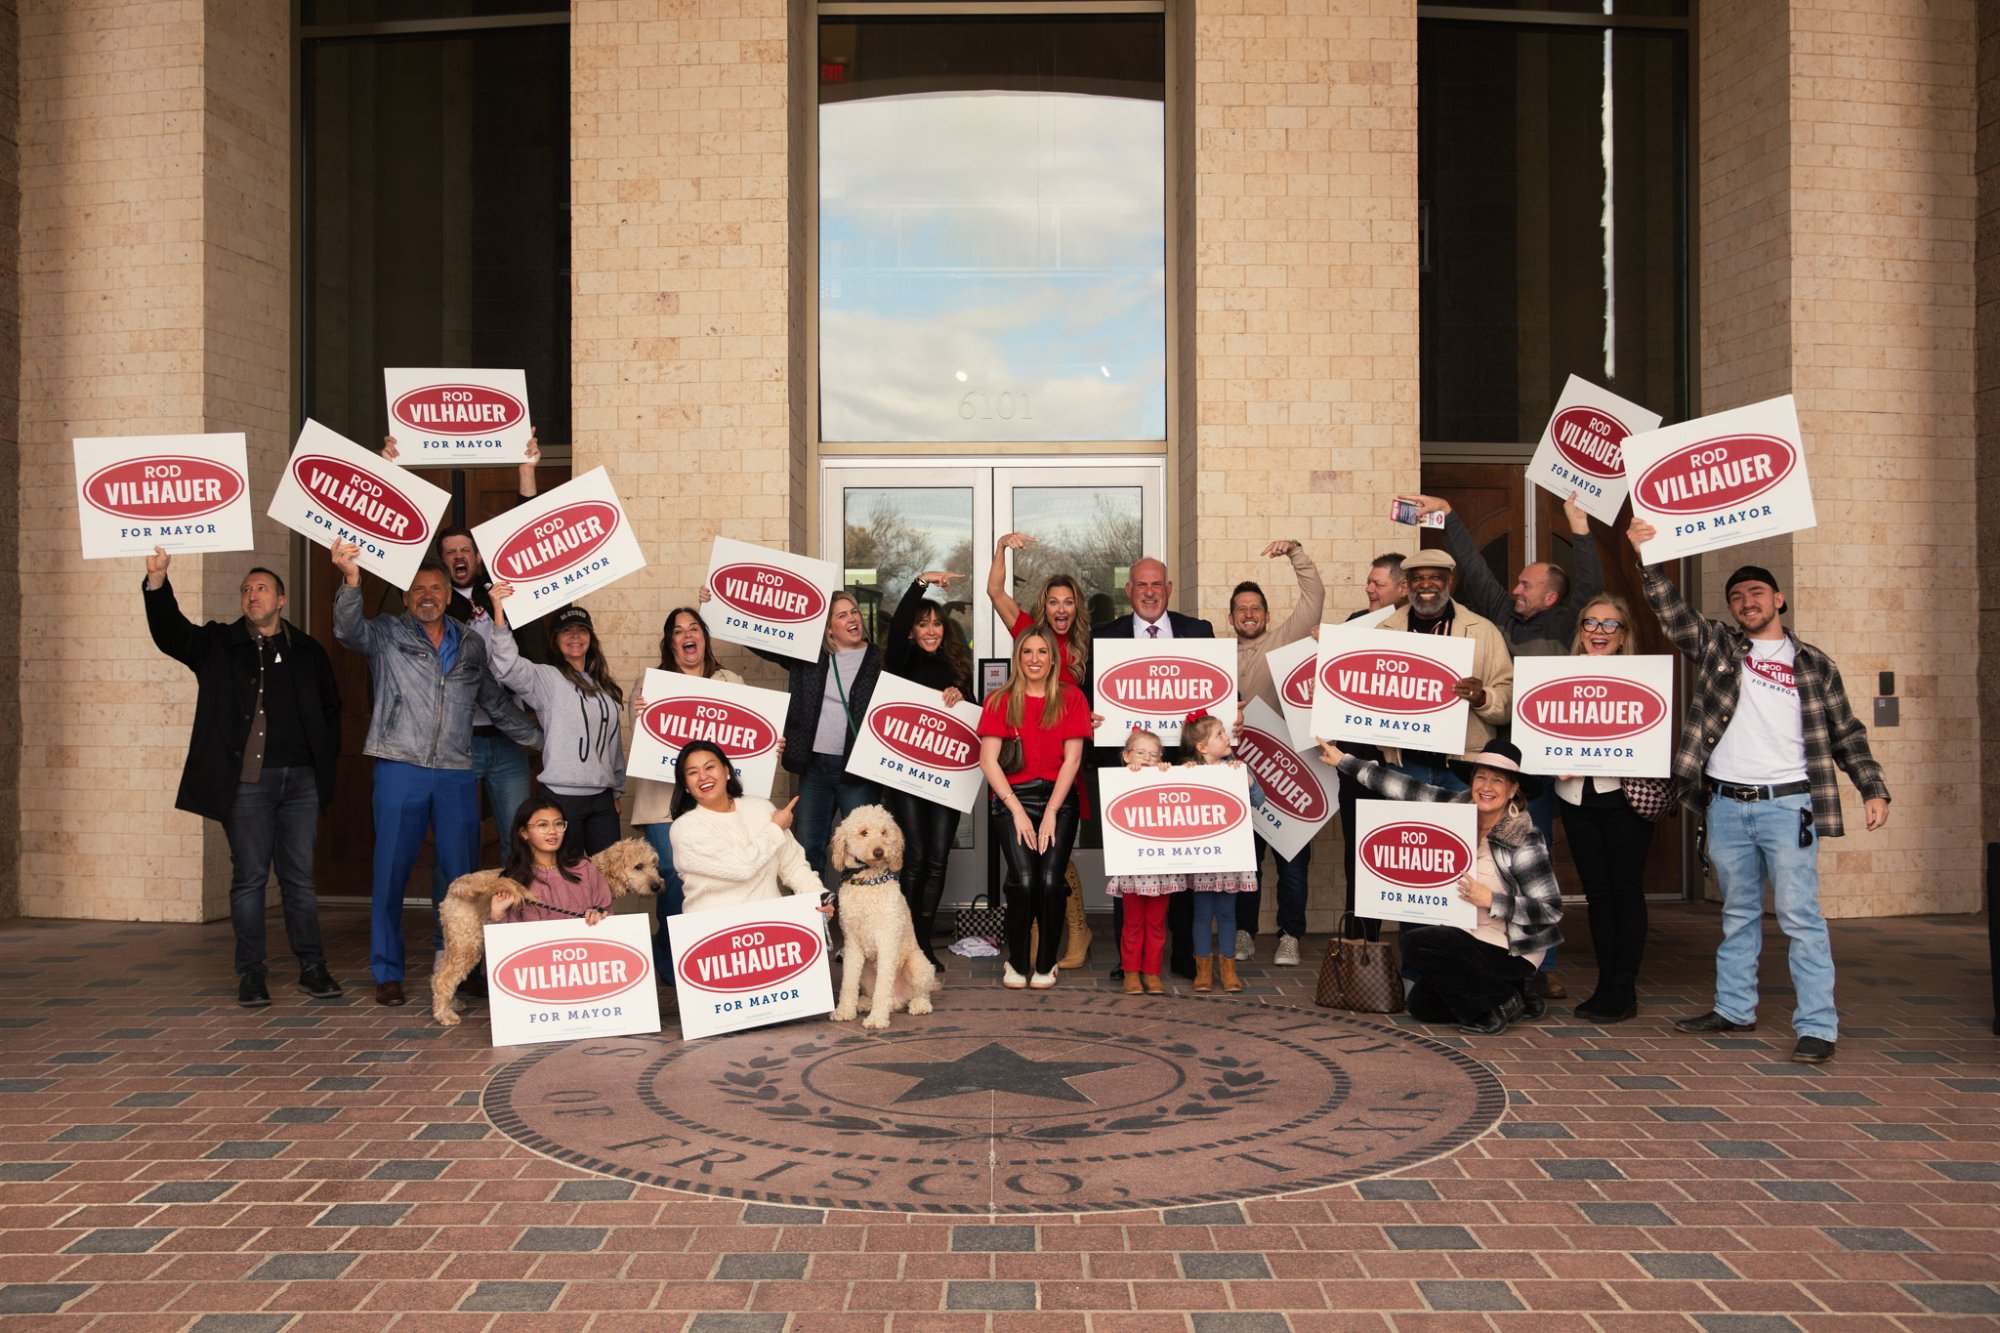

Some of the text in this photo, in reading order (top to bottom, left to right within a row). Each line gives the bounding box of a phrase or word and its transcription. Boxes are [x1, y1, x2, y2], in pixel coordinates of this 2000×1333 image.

[442, 391, 474, 402] ROD
[958, 391, 1033, 420] 6101
[409, 403, 507, 423] VILHAUER
[1588, 417, 1612, 437] ROD
[423, 440, 503, 449] FOR MAYOR
[1689, 447, 1728, 469] ROD
[144, 464, 182, 479] ROD
[1551, 463, 1603, 498] FOR MAYOR
[1653, 453, 1774, 505] VILHAUER
[104, 478, 223, 506] VILHAUER
[349, 473, 383, 498] ROD
[308, 467, 410, 538] VILHAUER
[121, 523, 217, 538] FOR MAYOR
[533, 517, 565, 540] ROD
[1675, 521, 1707, 537] FOR
[1713, 505, 1773, 528] MAYOR
[304, 510, 386, 559] FOR MAYOR
[507, 515, 605, 576] VILHAUER
[532, 581, 560, 600] FOR
[563, 557, 611, 585] MAYOR
[757, 571, 784, 587] ROD
[725, 577, 809, 616] VILHAUER
[725, 617, 749, 629] FOR
[753, 623, 795, 641] MAYOR
[1149, 664, 1181, 677] ROD
[1376, 658, 1410, 674] ROD
[1114, 678, 1214, 700] VILHAUER
[1338, 669, 1444, 703] VILHAUER
[1573, 685, 1608, 698] ROD
[696, 705, 728, 721] ROD
[918, 713, 947, 732] ROD
[1344, 715, 1431, 733] FOR MAYOR
[1535, 700, 1644, 725] VILHAUER
[659, 713, 758, 750] VILHAUER
[883, 715, 971, 765] VILHAUER
[661, 756, 677, 767] FO
[1272, 750, 1299, 775] ROD
[1545, 747, 1634, 758] FOR MAYOR
[879, 757, 904, 772] FOR
[908, 767, 951, 789] MAYOR
[1236, 737, 1313, 814] VILHAUER
[1158, 792, 1191, 804] ROD
[1123, 804, 1227, 828] VILHAUER
[1401, 831, 1428, 845] ROD
[1138, 846, 1222, 857] FOR MAYOR
[1373, 845, 1455, 874] VILHAUER
[1381, 891, 1448, 907] FOR MAYOR
[731, 932, 765, 950] ROD
[552, 947, 588, 963] ROD
[696, 941, 803, 982] VILHAUER
[513, 960, 628, 991] VILHAUER
[714, 989, 800, 1014] FOR MAYOR
[529, 1006, 623, 1024] FOR MAYOR
[1226, 1013, 1410, 1055] CITY
[544, 1089, 616, 1117] OF
